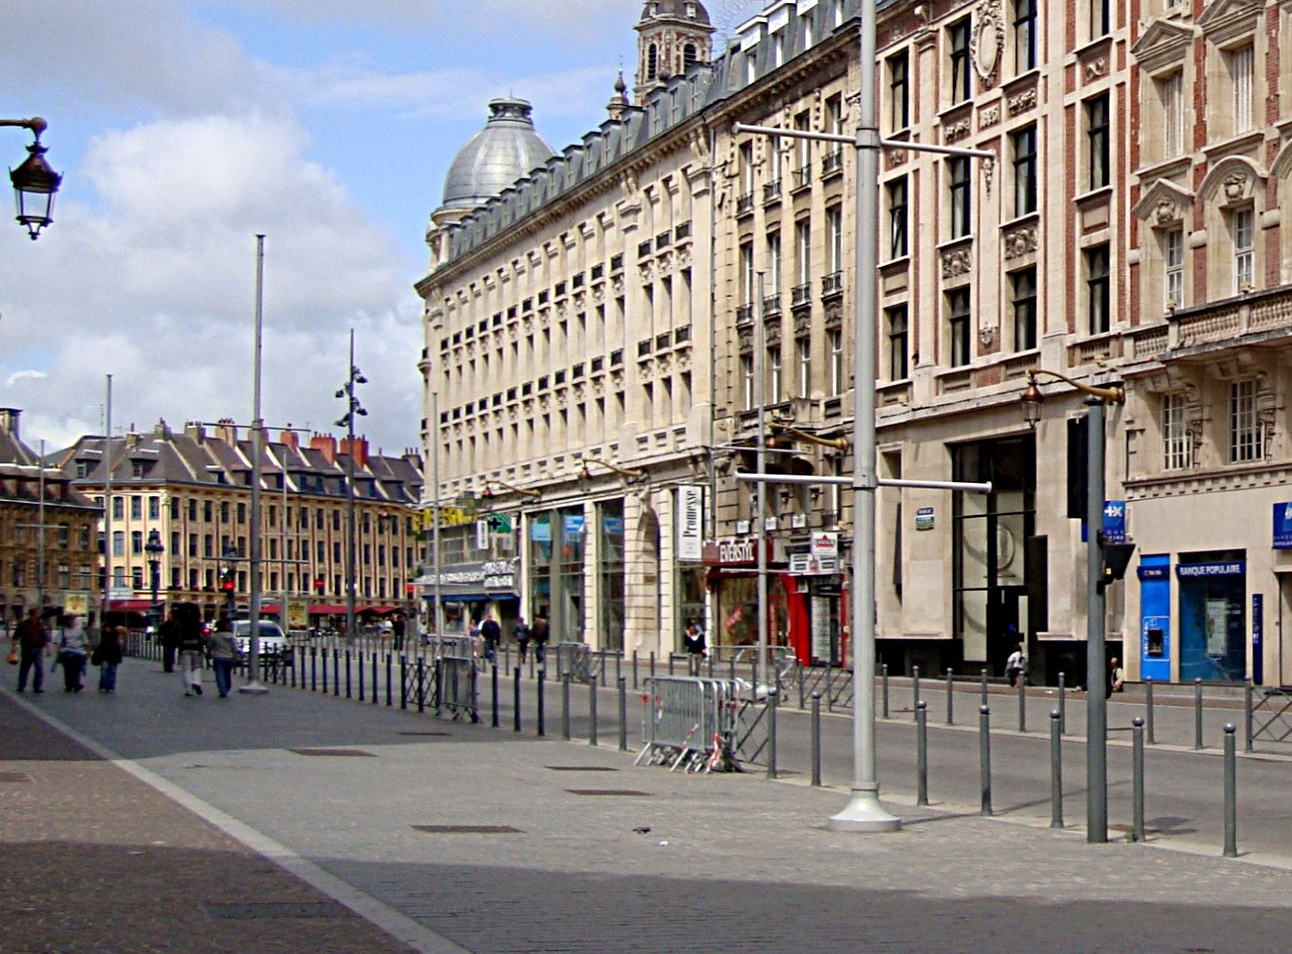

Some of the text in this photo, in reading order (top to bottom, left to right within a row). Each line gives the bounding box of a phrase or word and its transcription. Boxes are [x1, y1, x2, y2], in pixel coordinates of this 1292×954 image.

[683, 490, 698, 537] Promesse
[1179, 563, 1241, 577] BANQUE POPULAIRE
